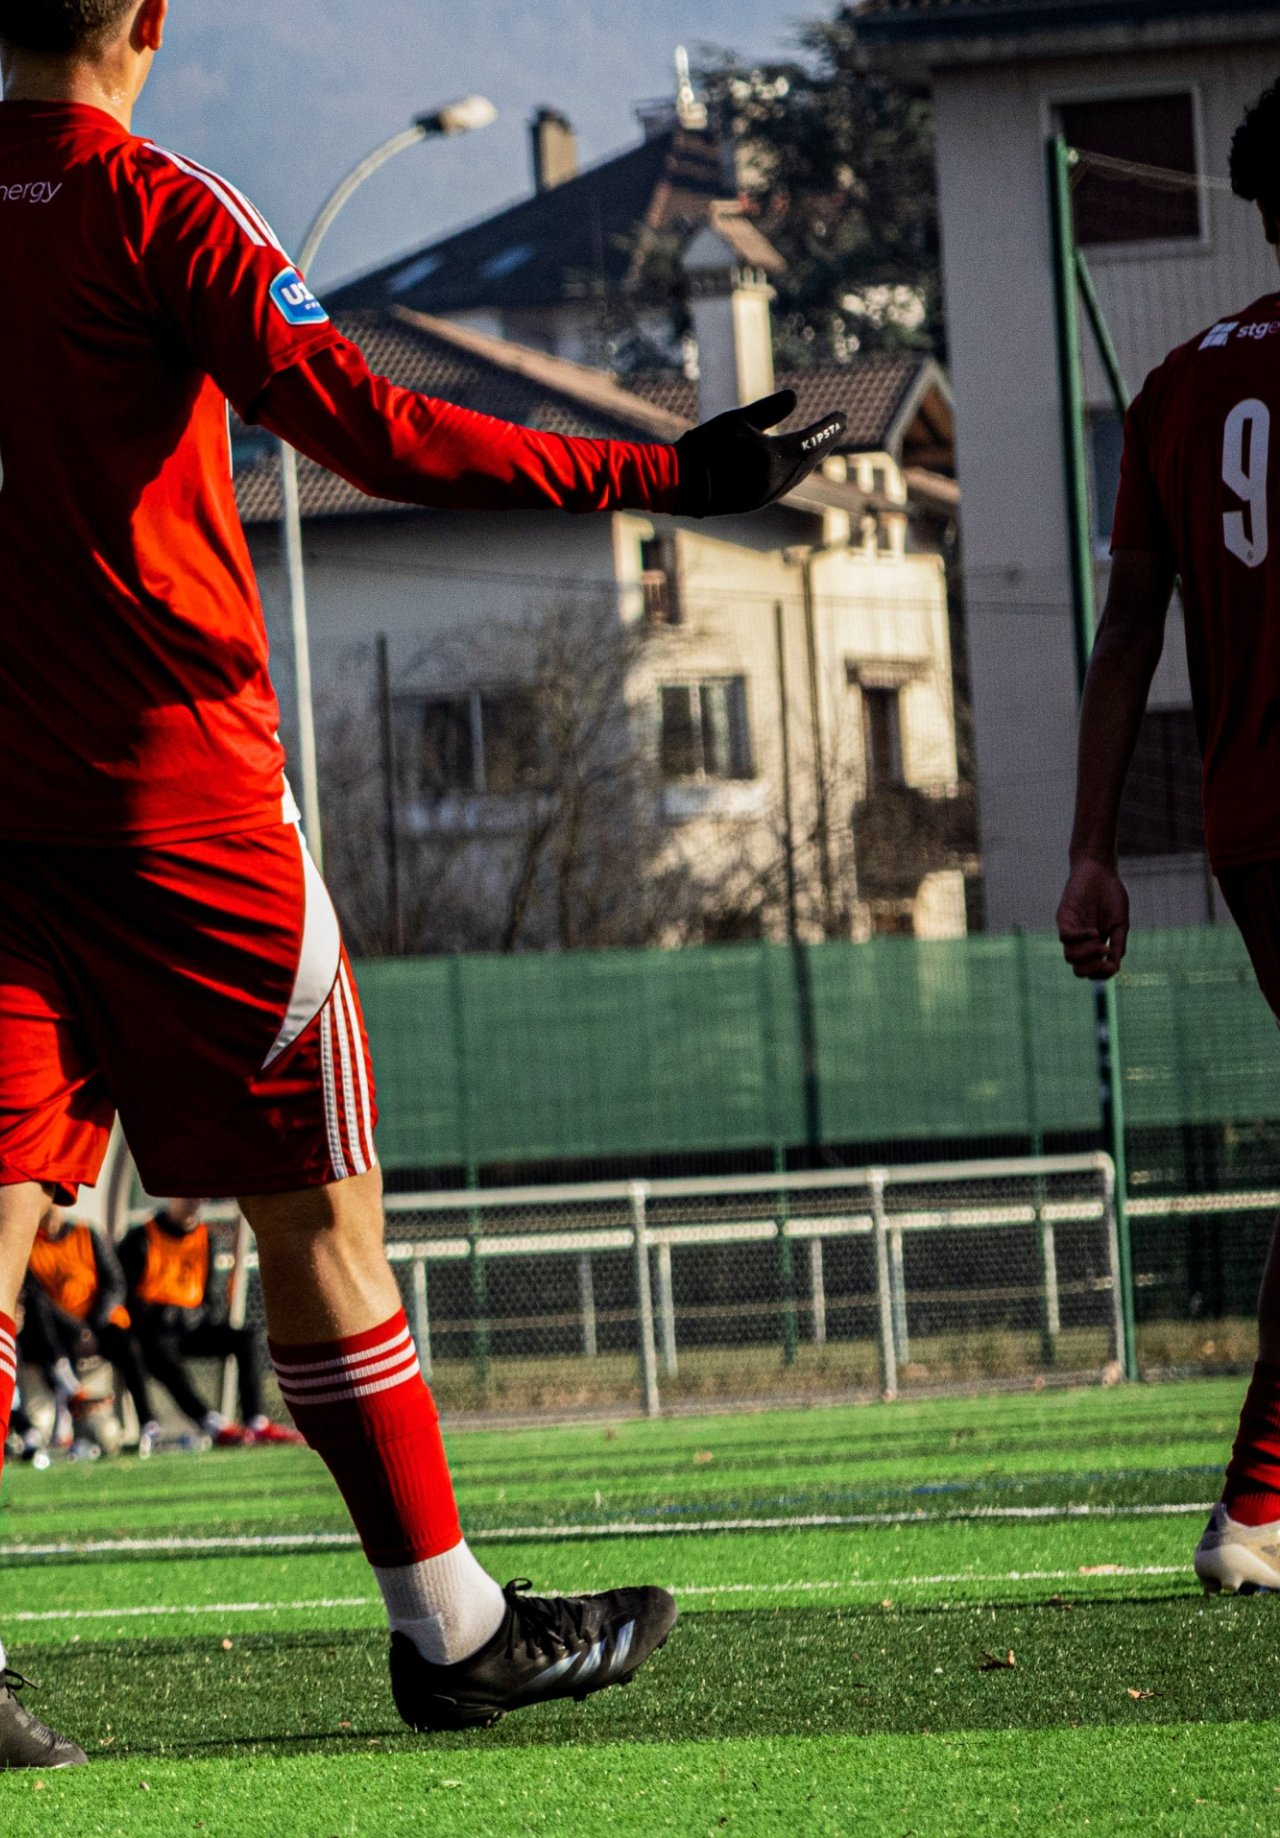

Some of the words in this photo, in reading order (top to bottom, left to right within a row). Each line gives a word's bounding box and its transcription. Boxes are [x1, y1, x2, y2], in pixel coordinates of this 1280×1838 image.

[1236, 321, 1280, 340] stge
[801, 422, 841, 450] KIPSTA
[1222, 398, 1270, 568] 9
